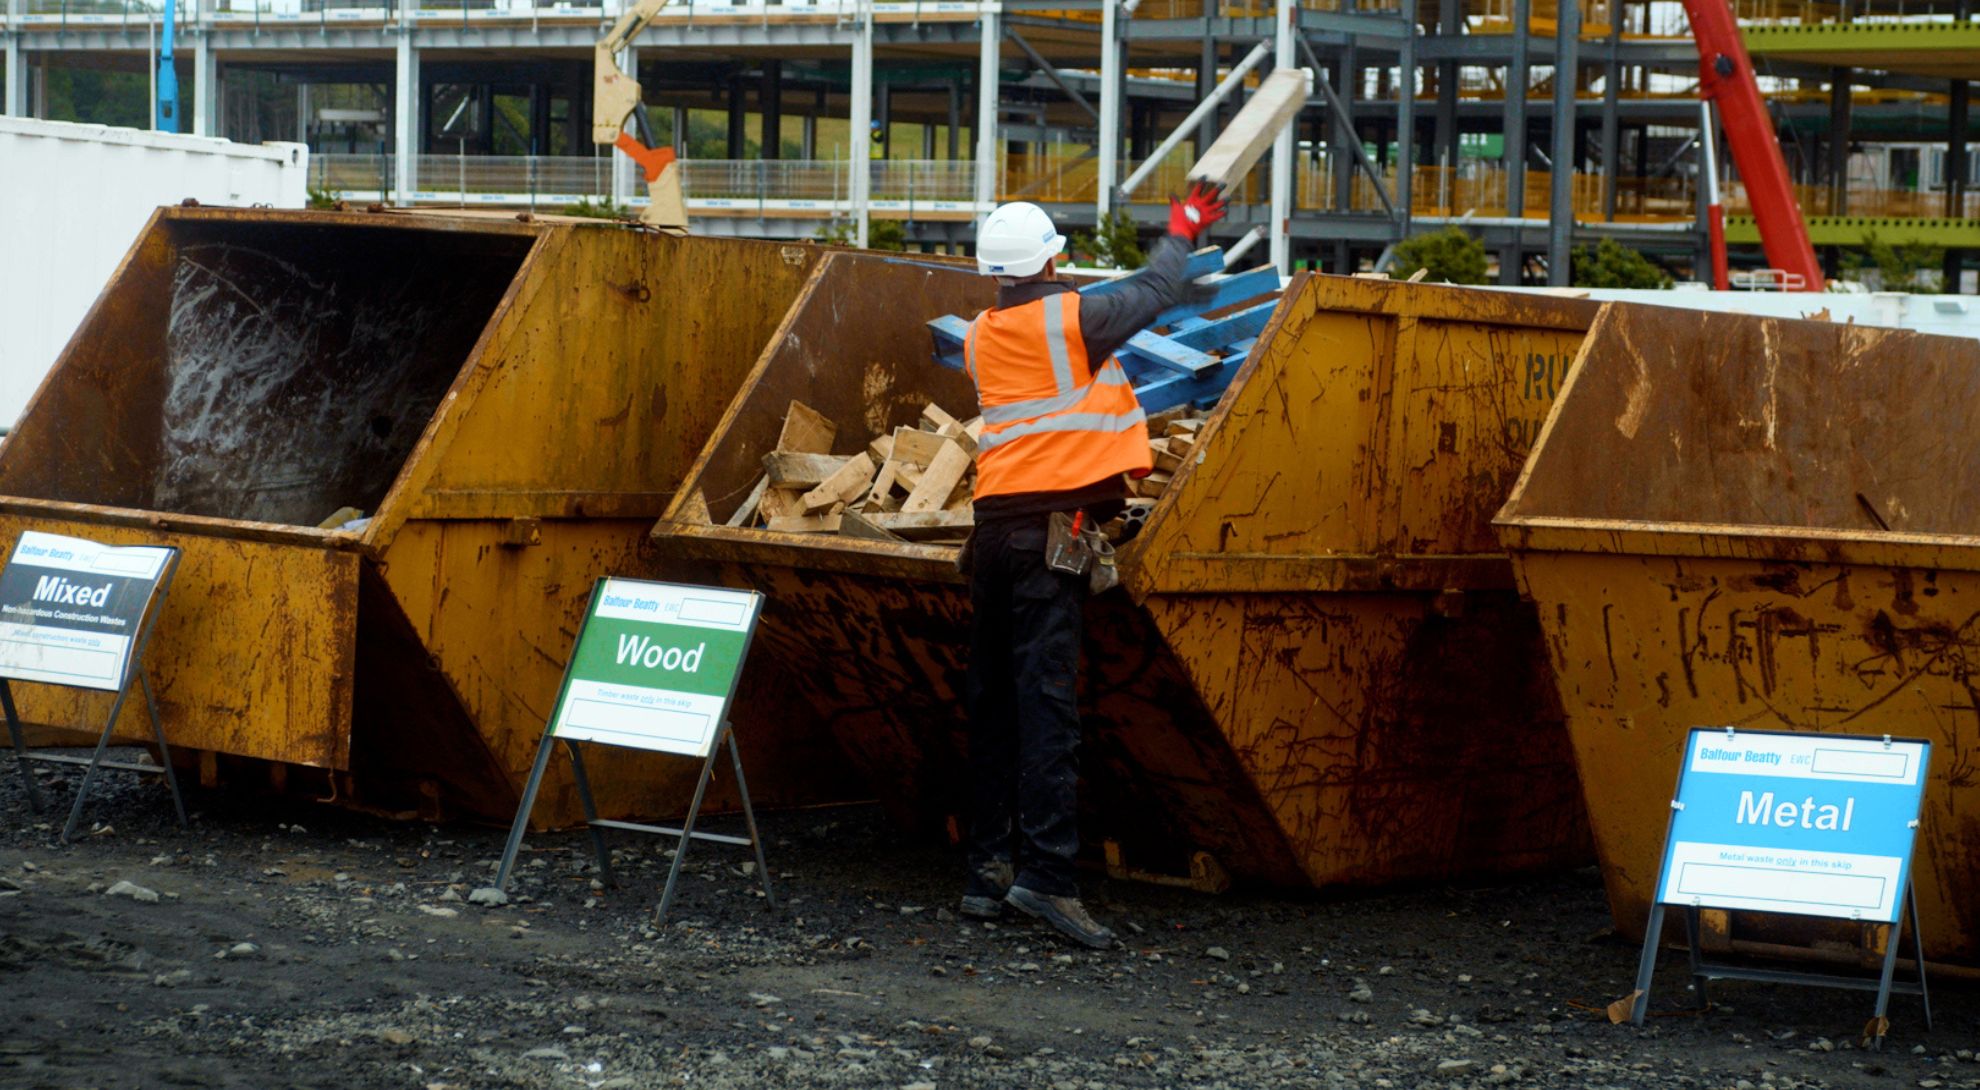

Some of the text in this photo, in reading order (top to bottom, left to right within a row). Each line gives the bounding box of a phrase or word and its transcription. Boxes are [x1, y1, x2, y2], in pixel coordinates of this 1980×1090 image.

[33, 575, 112, 608] Mixed
[603, 594, 632, 607] Balfour
[633, 598, 659, 612] Beatty
[2, 604, 126, 626] Non-hazardous Construction Wastes
[616, 633, 706, 673] Wood
[1700, 747, 1811, 765] Balfour Beatty EWC
[1736, 790, 1855, 832] Metal
[1720, 852, 1853, 870] Metal waste only in this skip
